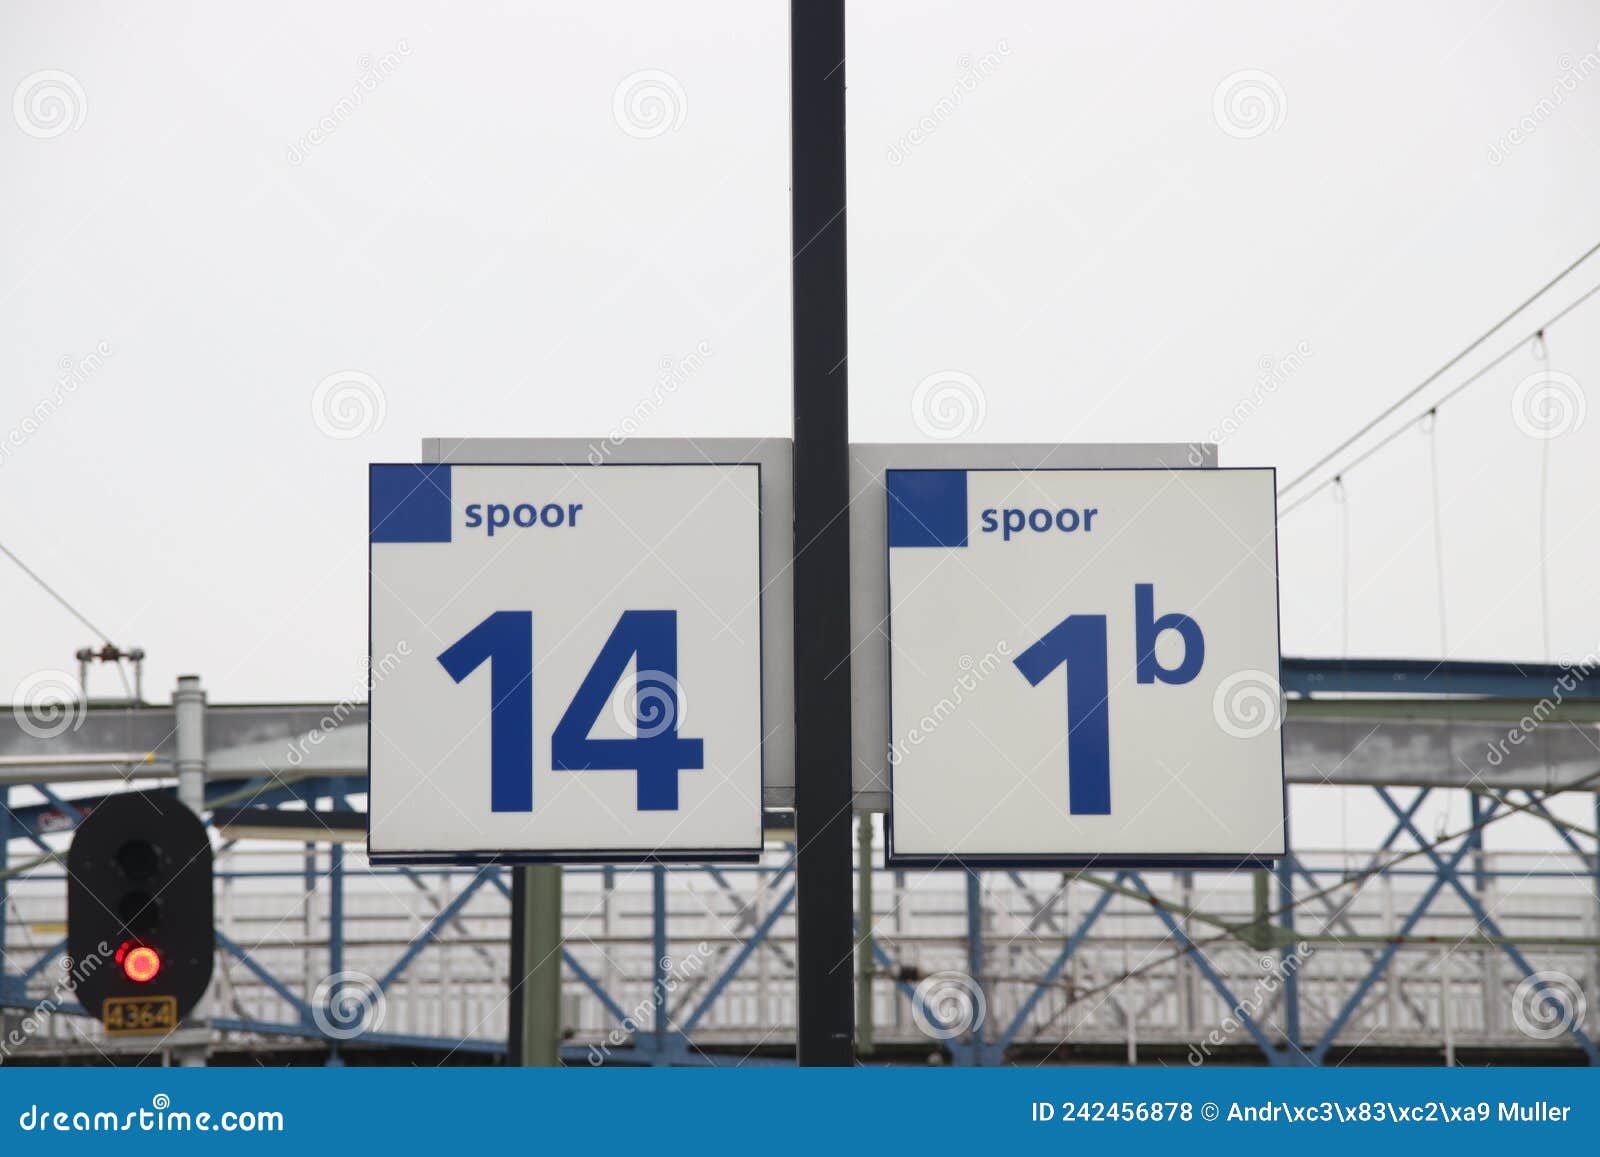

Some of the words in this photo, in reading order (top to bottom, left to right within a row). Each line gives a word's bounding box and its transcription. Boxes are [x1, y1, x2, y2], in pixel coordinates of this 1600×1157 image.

[464, 498, 584, 535] spoor
[980, 502, 1098, 540] spoor
[437, 609, 704, 813] 14
[106, 1002, 170, 1028] 4364
